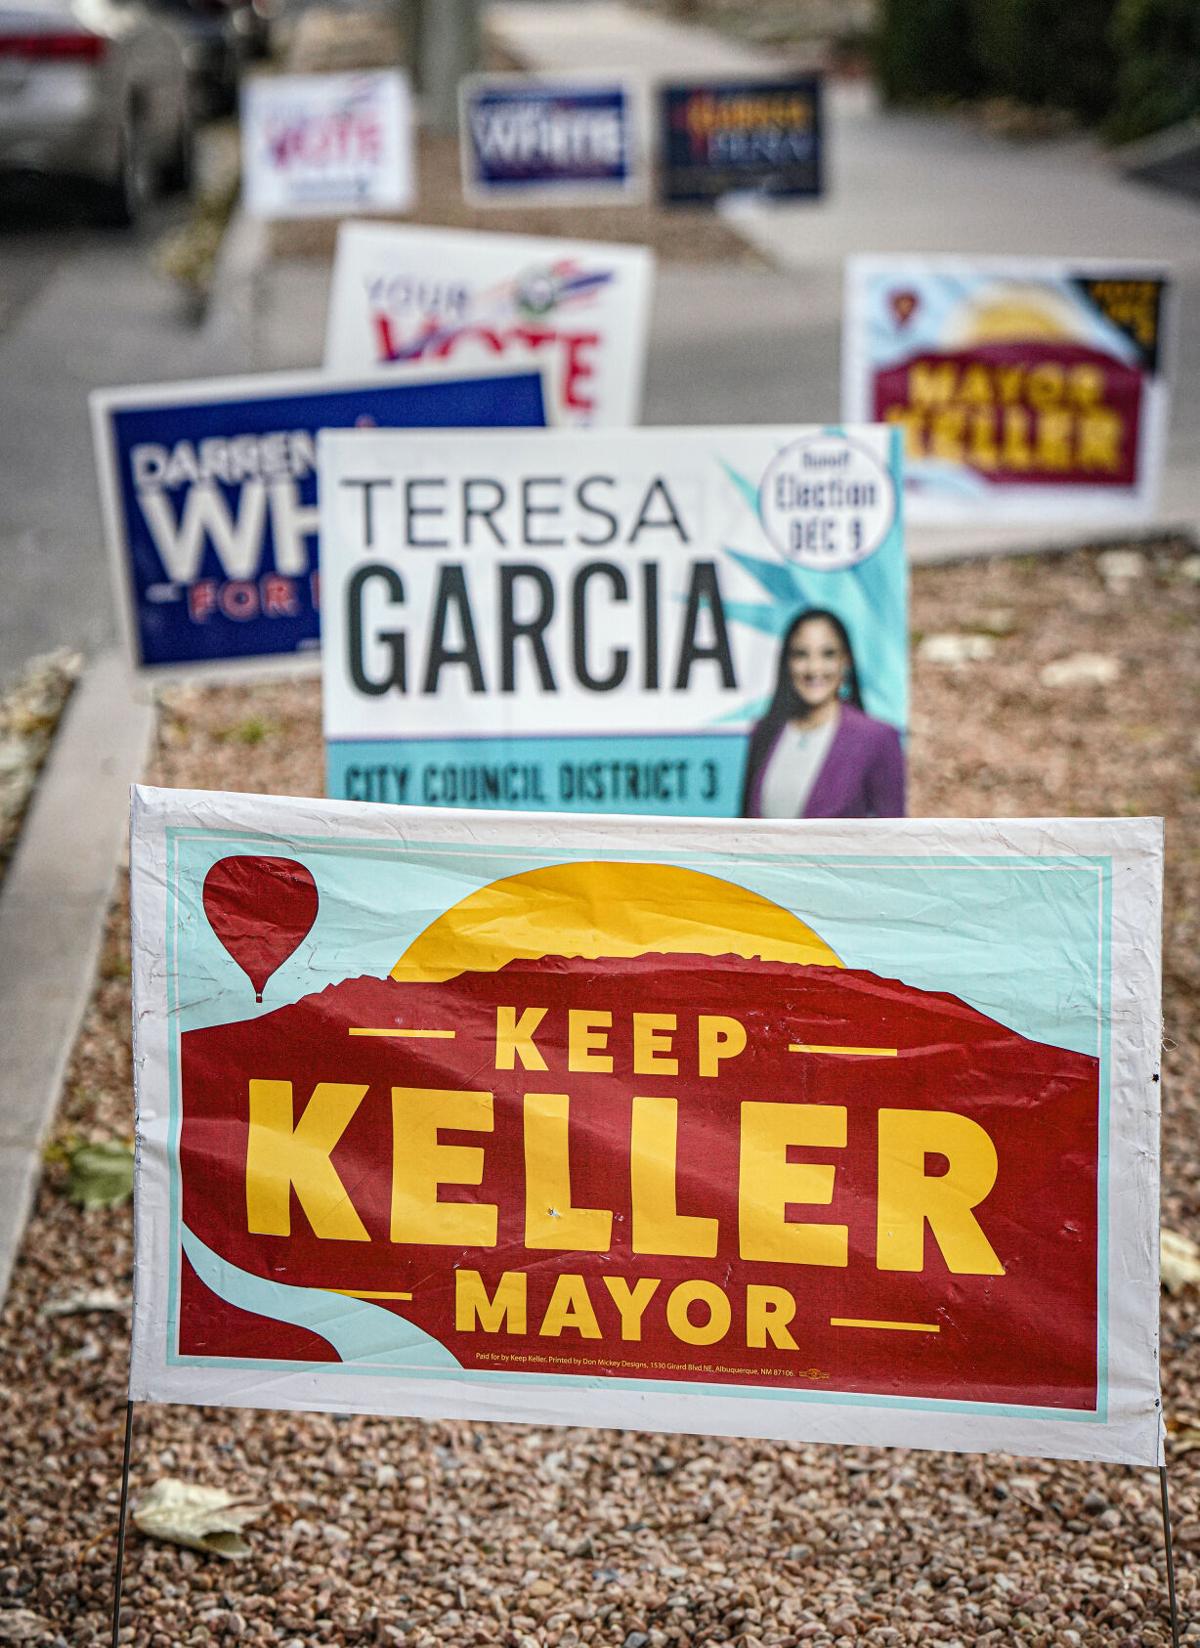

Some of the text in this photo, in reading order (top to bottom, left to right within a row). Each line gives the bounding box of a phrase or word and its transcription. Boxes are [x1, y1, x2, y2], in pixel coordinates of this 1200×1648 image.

[908, 361, 1103, 405] MAYOR
[131, 431, 317, 487] DARREN
[340, 475, 690, 549] TERESA
[775, 472, 877, 510] Election
[789, 518, 863, 553] DEC 9
[188, 570, 299, 624] FOR
[346, 559, 739, 697] GARCIA
[345, 760, 720, 803] CITY COUNCIL DISTRICT 3
[495, 1006, 748, 1078] KEEP
[246, 1078, 1006, 1277] KELLER
[455, 1268, 801, 1351] MAYOR
[475, 1352, 490, 1360] Paid
[501, 1353, 510, 1362] by
[510, 1354, 528, 1363] Keep
[549, 1356, 572, 1365] Printed
[573, 1357, 581, 1366] by
[582, 1358, 597, 1366] Don
[598, 1359, 620, 1368] Mickey
[621, 1360, 649, 1370] Designs,
[667, 1362, 687, 1371] Girard
[688, 1364, 703, 1372] Blvd
[715, 1365, 760, 1375] Albuquerque,
[760, 1368, 772, 1376] NM
